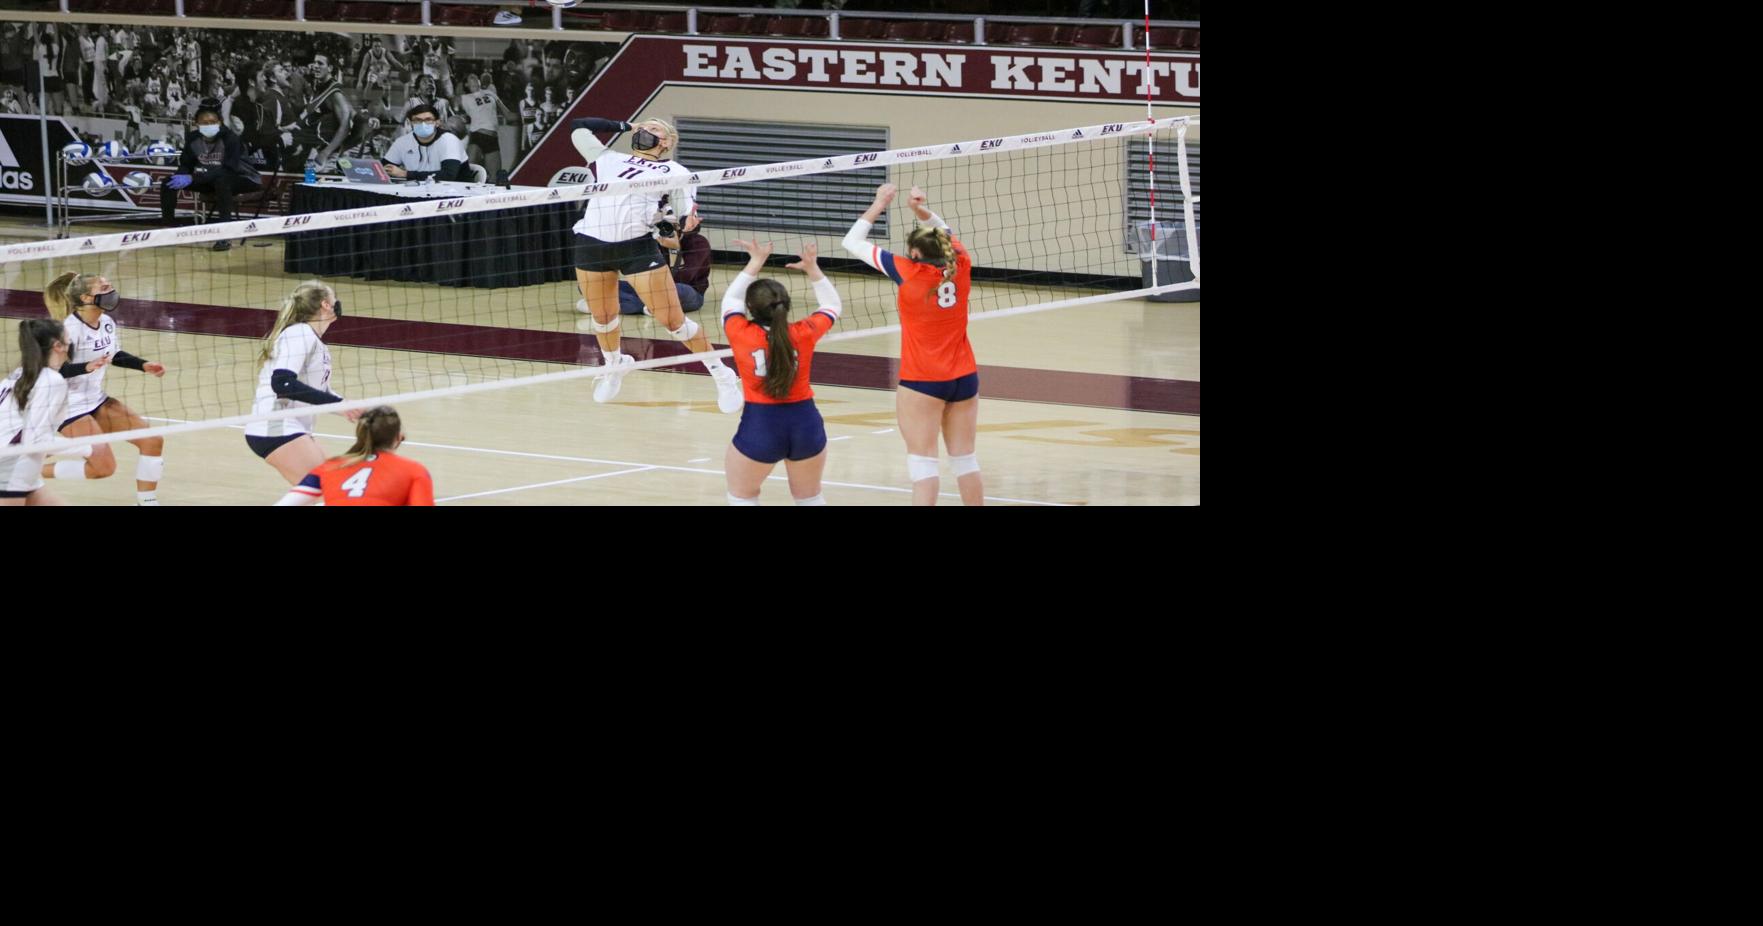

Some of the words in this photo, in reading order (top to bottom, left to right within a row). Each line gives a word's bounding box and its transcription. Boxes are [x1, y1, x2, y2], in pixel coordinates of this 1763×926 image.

[683, 44, 966, 88] EASTERN
[990, 55, 1200, 97] KENTU
[0, 165, 33, 190] as
[122, 232, 151, 243] EKU
[284, 215, 312, 226] EKU
[438, 200, 464, 209] EKU
[583, 183, 609, 193] EKU
[722, 168, 746, 178] EKU
[855, 153, 877, 163] EKU
[981, 139, 1003, 148] EKU
[1102, 124, 1122, 133] EKU
[558, 172, 588, 183] EKU
[617, 167, 644, 180] 11
[937, 281, 957, 308] 8
[341, 467, 373, 498] 4
